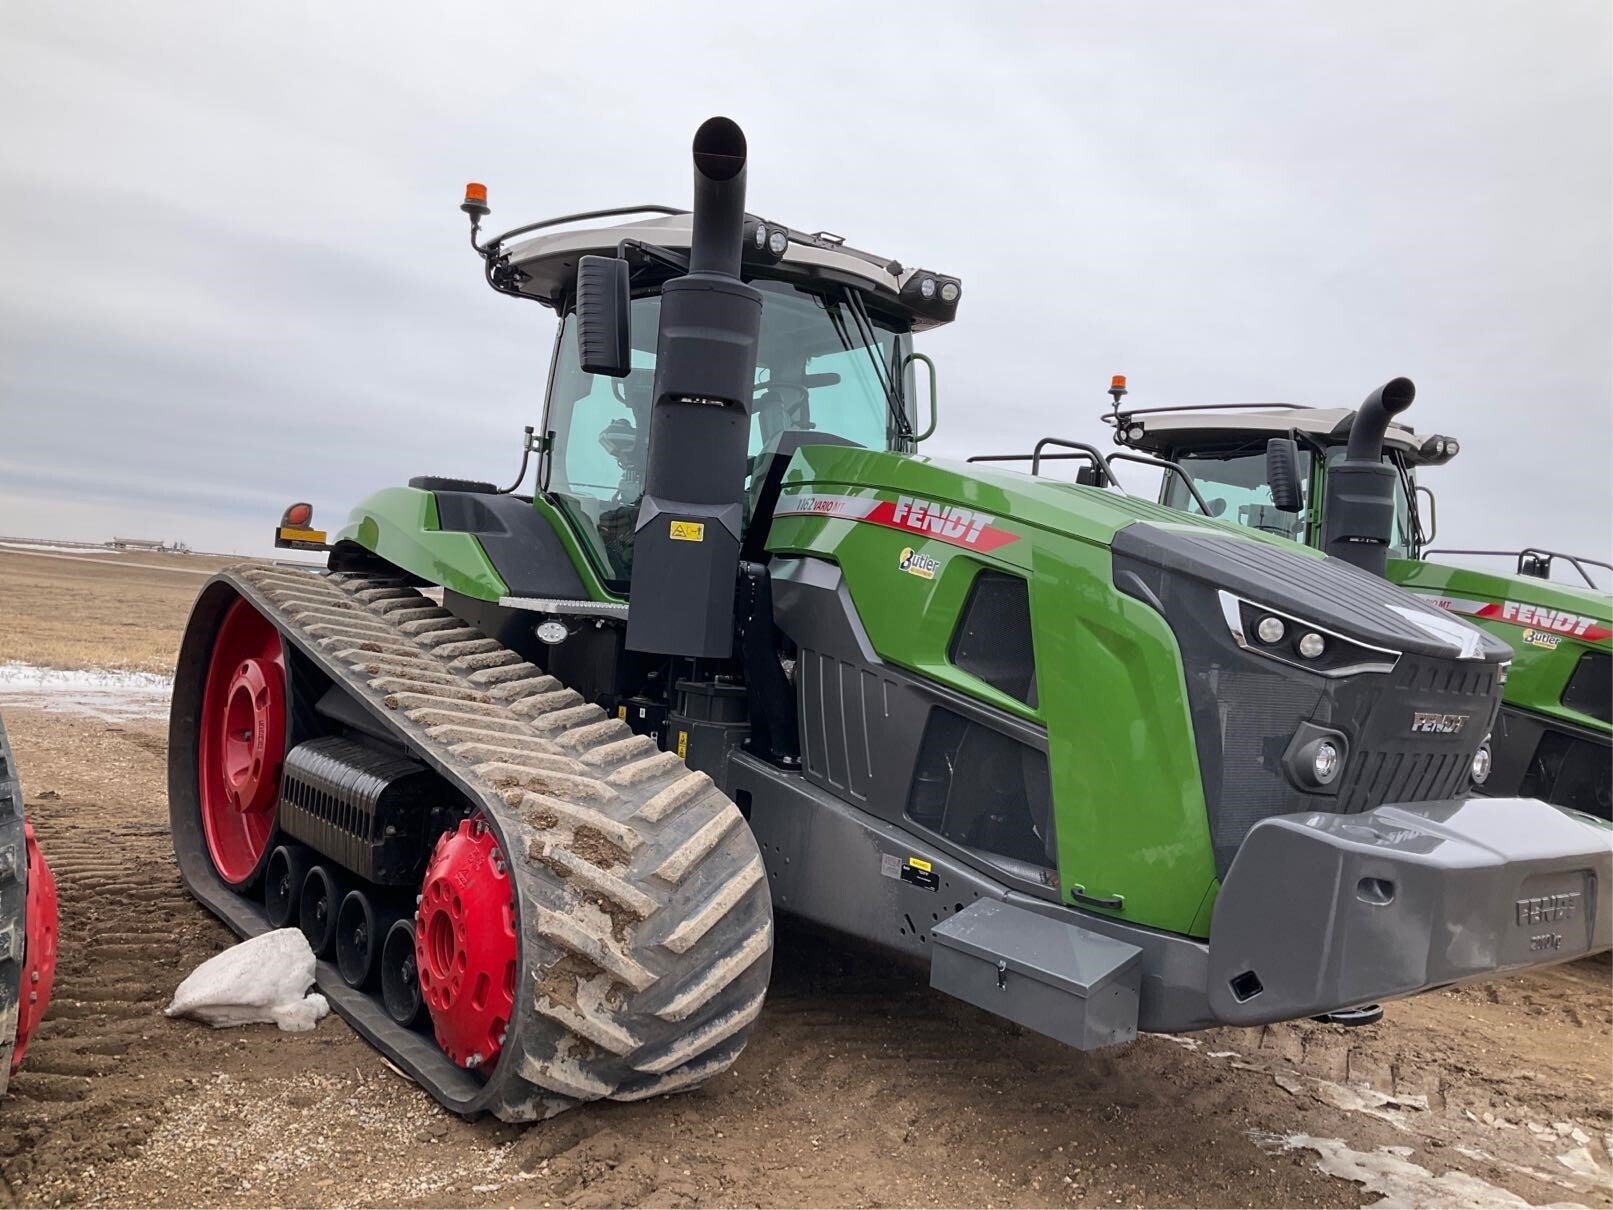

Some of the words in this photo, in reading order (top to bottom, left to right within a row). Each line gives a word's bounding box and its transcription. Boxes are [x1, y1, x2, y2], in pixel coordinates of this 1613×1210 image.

[892, 494, 995, 543] FENDT
[900, 549, 939, 571] Butler
[1502, 600, 1599, 636] FENDT
[1524, 629, 1560, 645] Butler
[1411, 712, 1470, 733] FENDT
